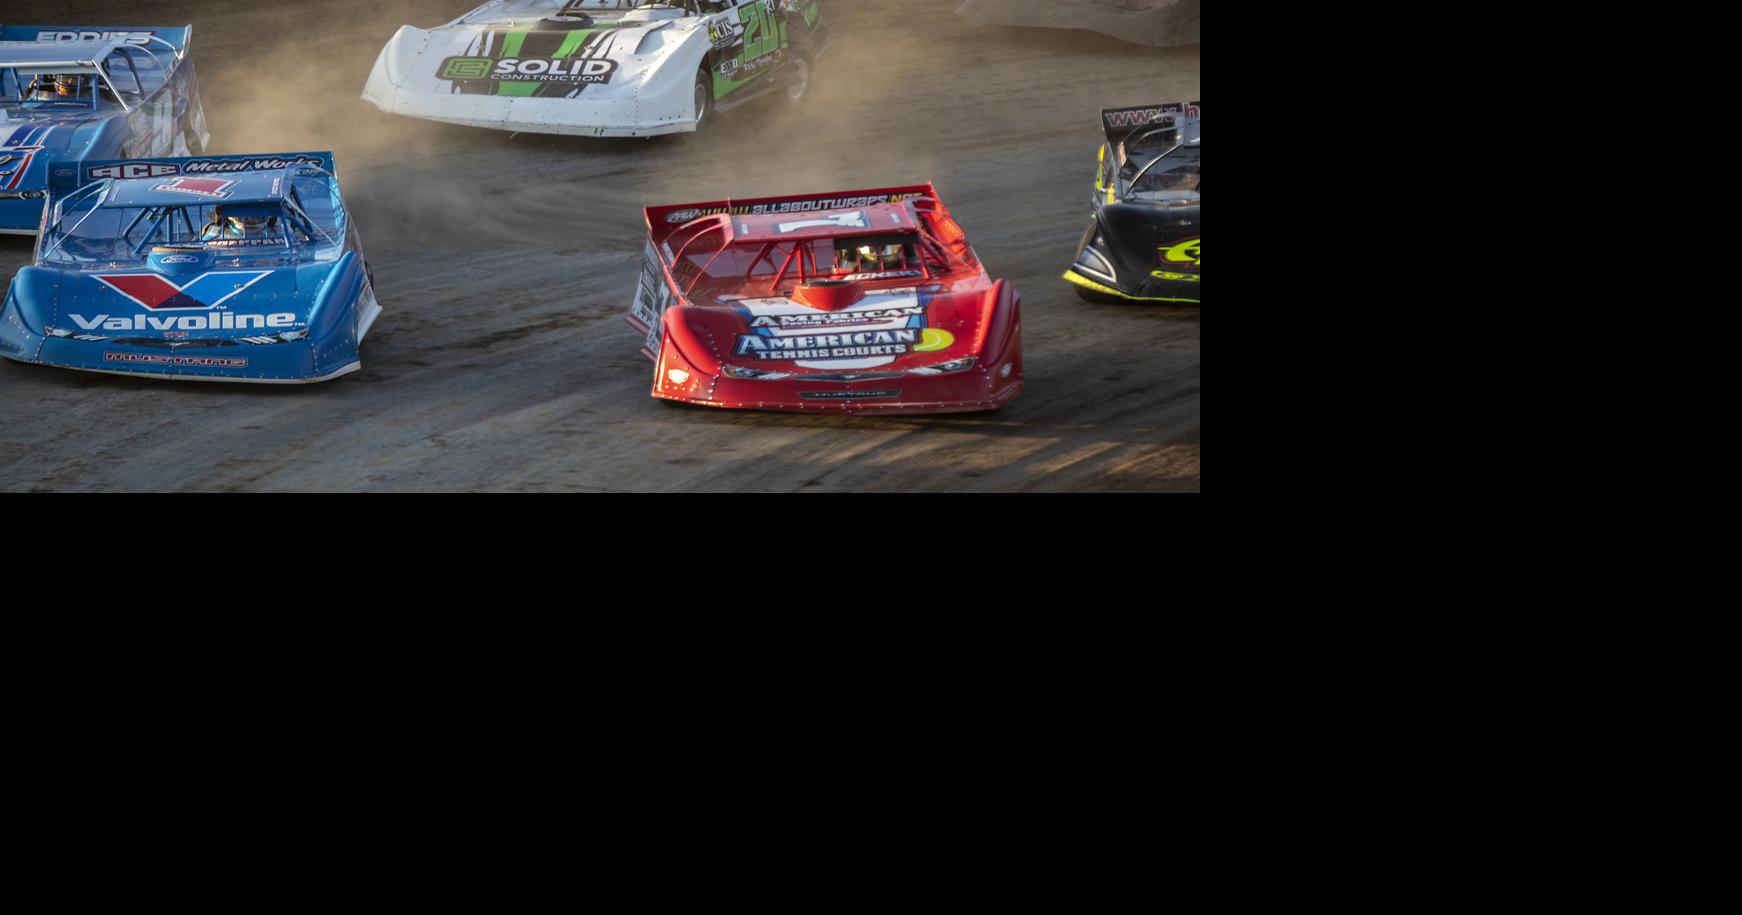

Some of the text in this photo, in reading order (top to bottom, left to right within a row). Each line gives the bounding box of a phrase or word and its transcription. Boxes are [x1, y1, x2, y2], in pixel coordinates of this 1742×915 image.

[494, 58, 612, 75] SOLID
[490, 73, 605, 82] CONSTRUCTION
[92, 164, 176, 178] ACE
[185, 161, 249, 172] Metal
[69, 311, 296, 330] Valvoline
[751, 306, 924, 327] AMERICAN
[739, 329, 917, 354] AMERICAN
[757, 350, 829, 359] TENNIS
[833, 345, 906, 357] COURTS
